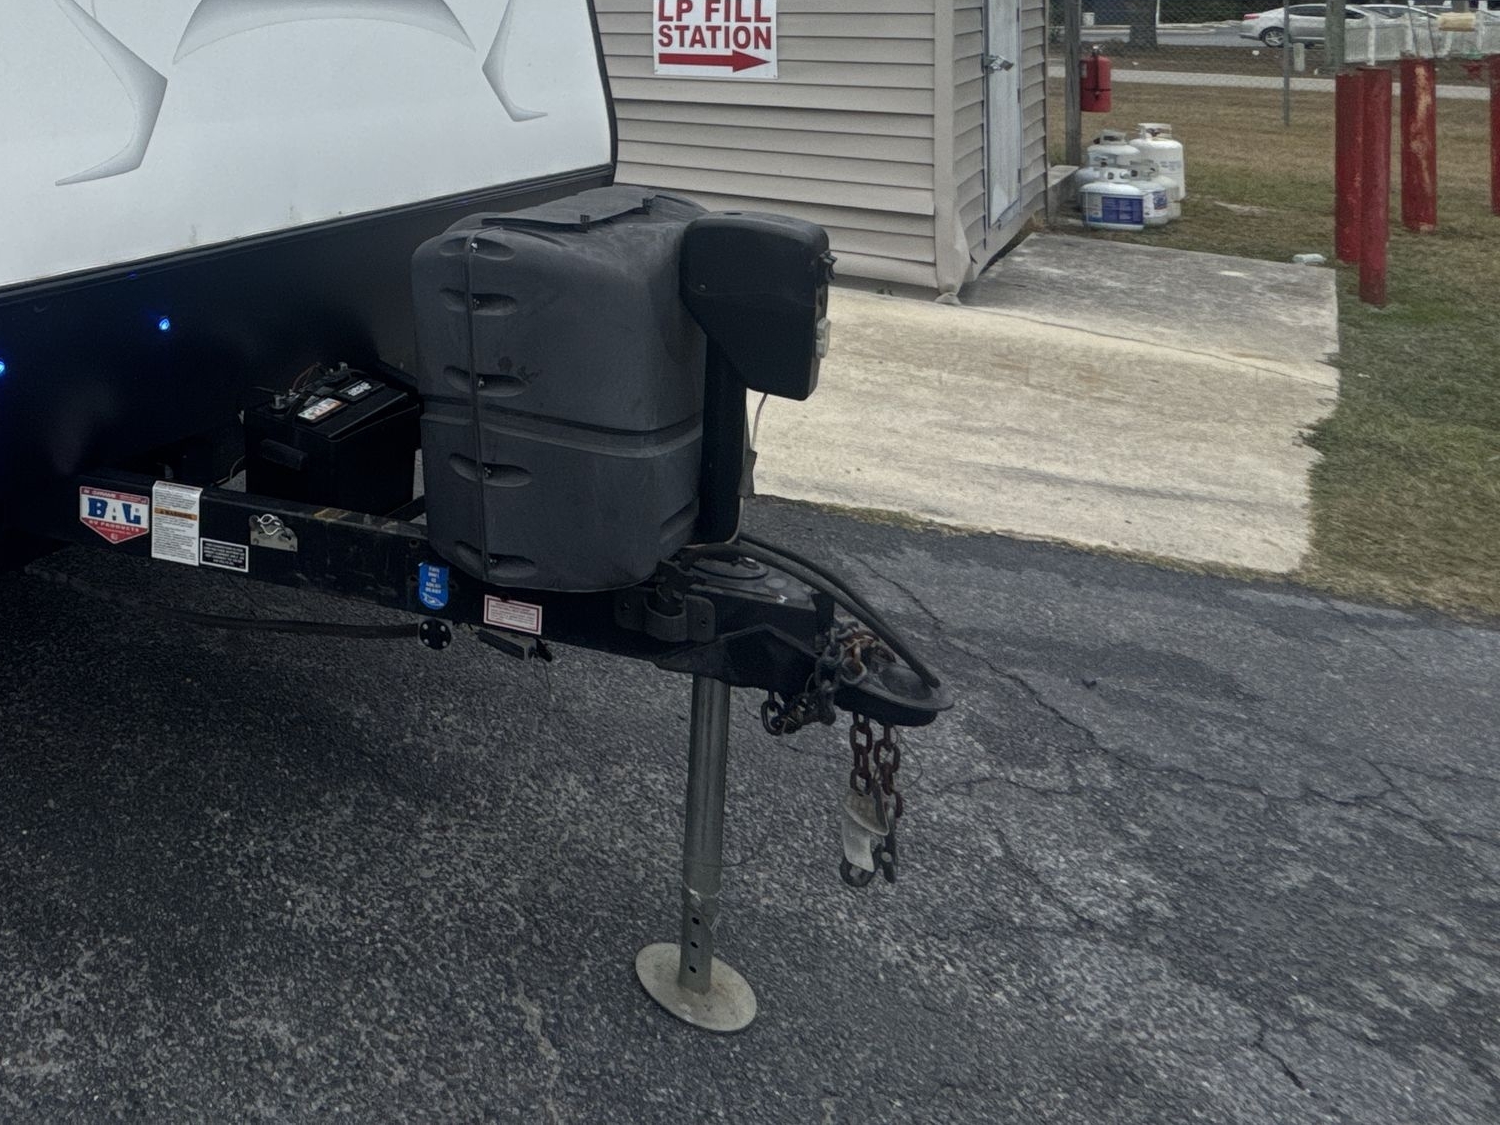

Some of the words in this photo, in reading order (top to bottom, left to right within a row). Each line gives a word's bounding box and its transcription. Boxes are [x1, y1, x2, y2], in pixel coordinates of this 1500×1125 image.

[658, 0, 693, 22] LP
[705, 0, 772, 23] FILL
[658, 24, 772, 50] STATION
[88, 497, 141, 525] BAL
